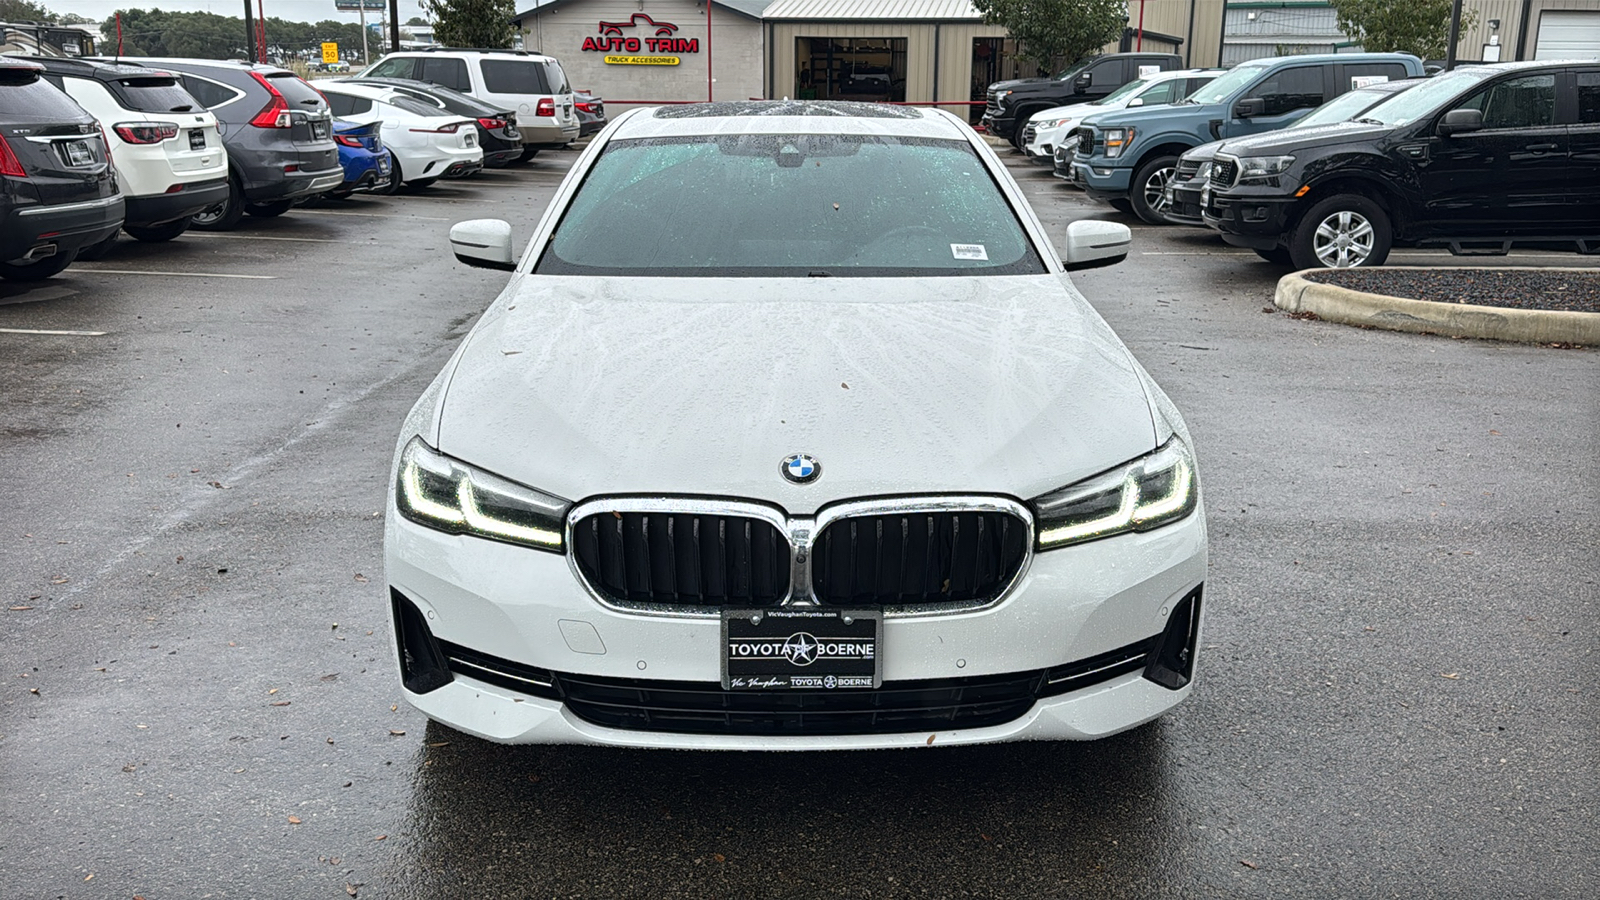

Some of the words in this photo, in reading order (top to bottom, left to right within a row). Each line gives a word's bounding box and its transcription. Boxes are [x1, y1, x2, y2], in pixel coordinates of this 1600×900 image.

[582, 37, 641, 52] AUTO
[645, 37, 699, 53] TRIM
[729, 643, 792, 656] TOYOTA
[817, 644, 874, 655] BOERNE
[731, 678, 746, 688] Vic
[748, 676, 788, 688] Vaughan
